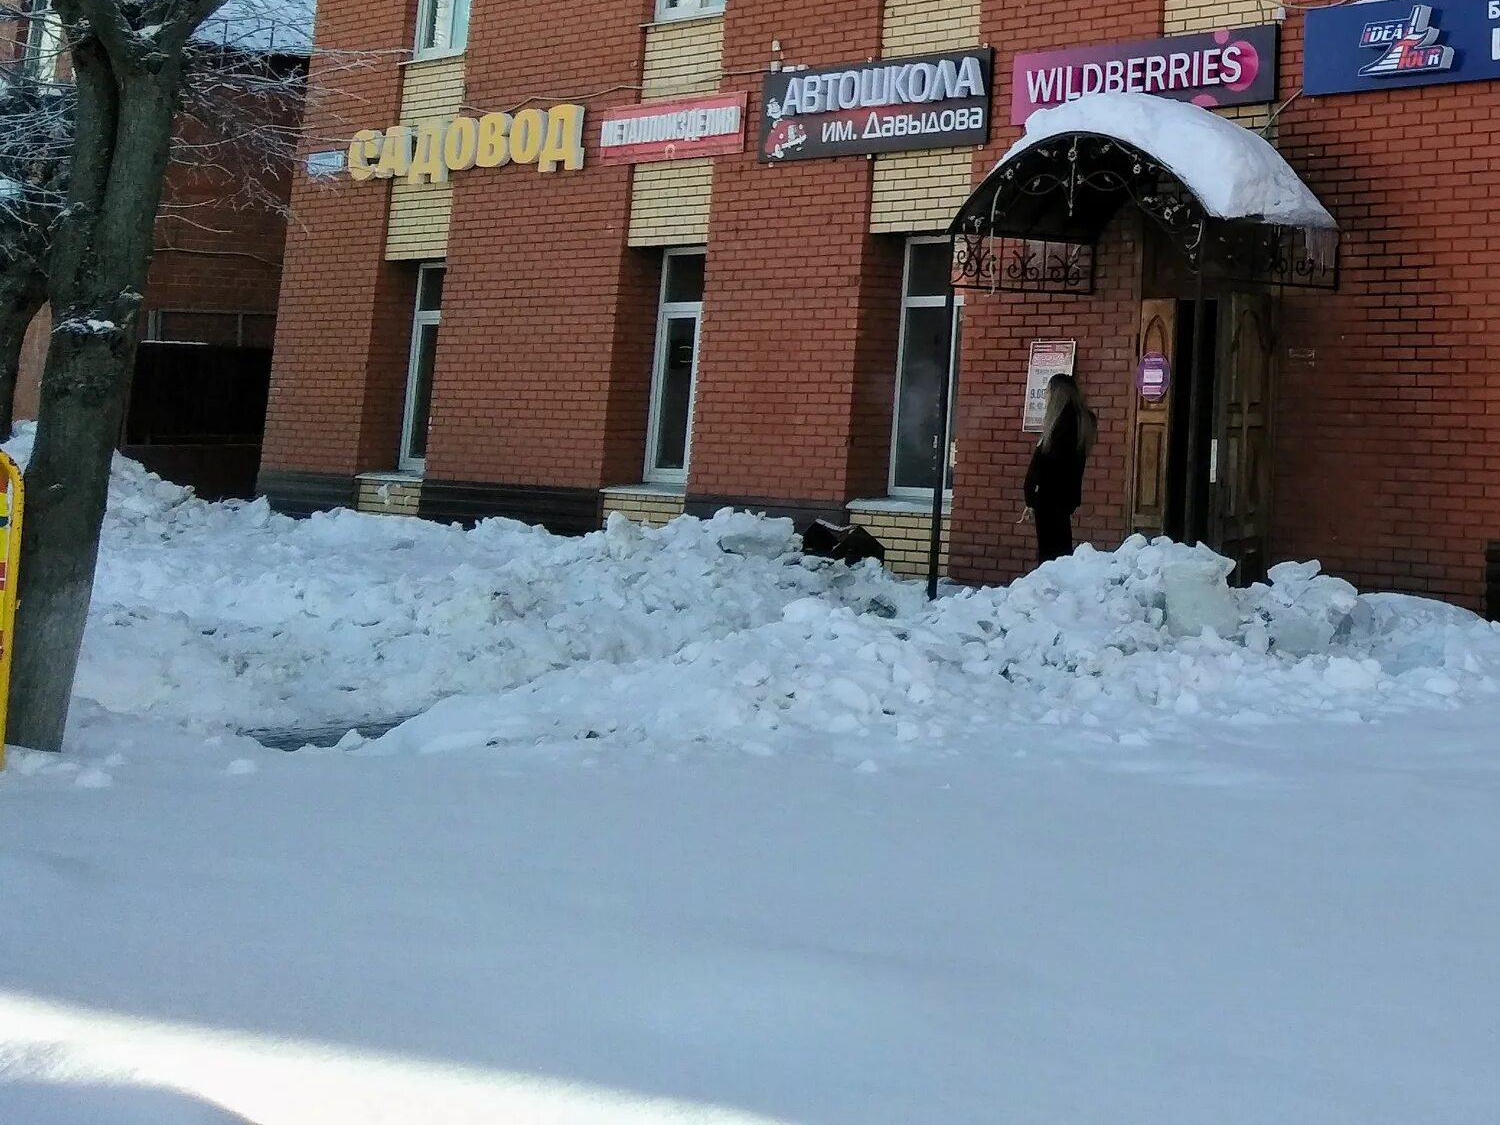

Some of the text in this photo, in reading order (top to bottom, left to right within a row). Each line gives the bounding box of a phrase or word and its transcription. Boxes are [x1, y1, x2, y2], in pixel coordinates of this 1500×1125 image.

[781, 56, 986, 116] АВТОШКОЛА
[1026, 46, 1243, 103] WILDBERRIES
[348, 104, 585, 185] САДОВОД
[862, 106, 984, 140] Давыдова
